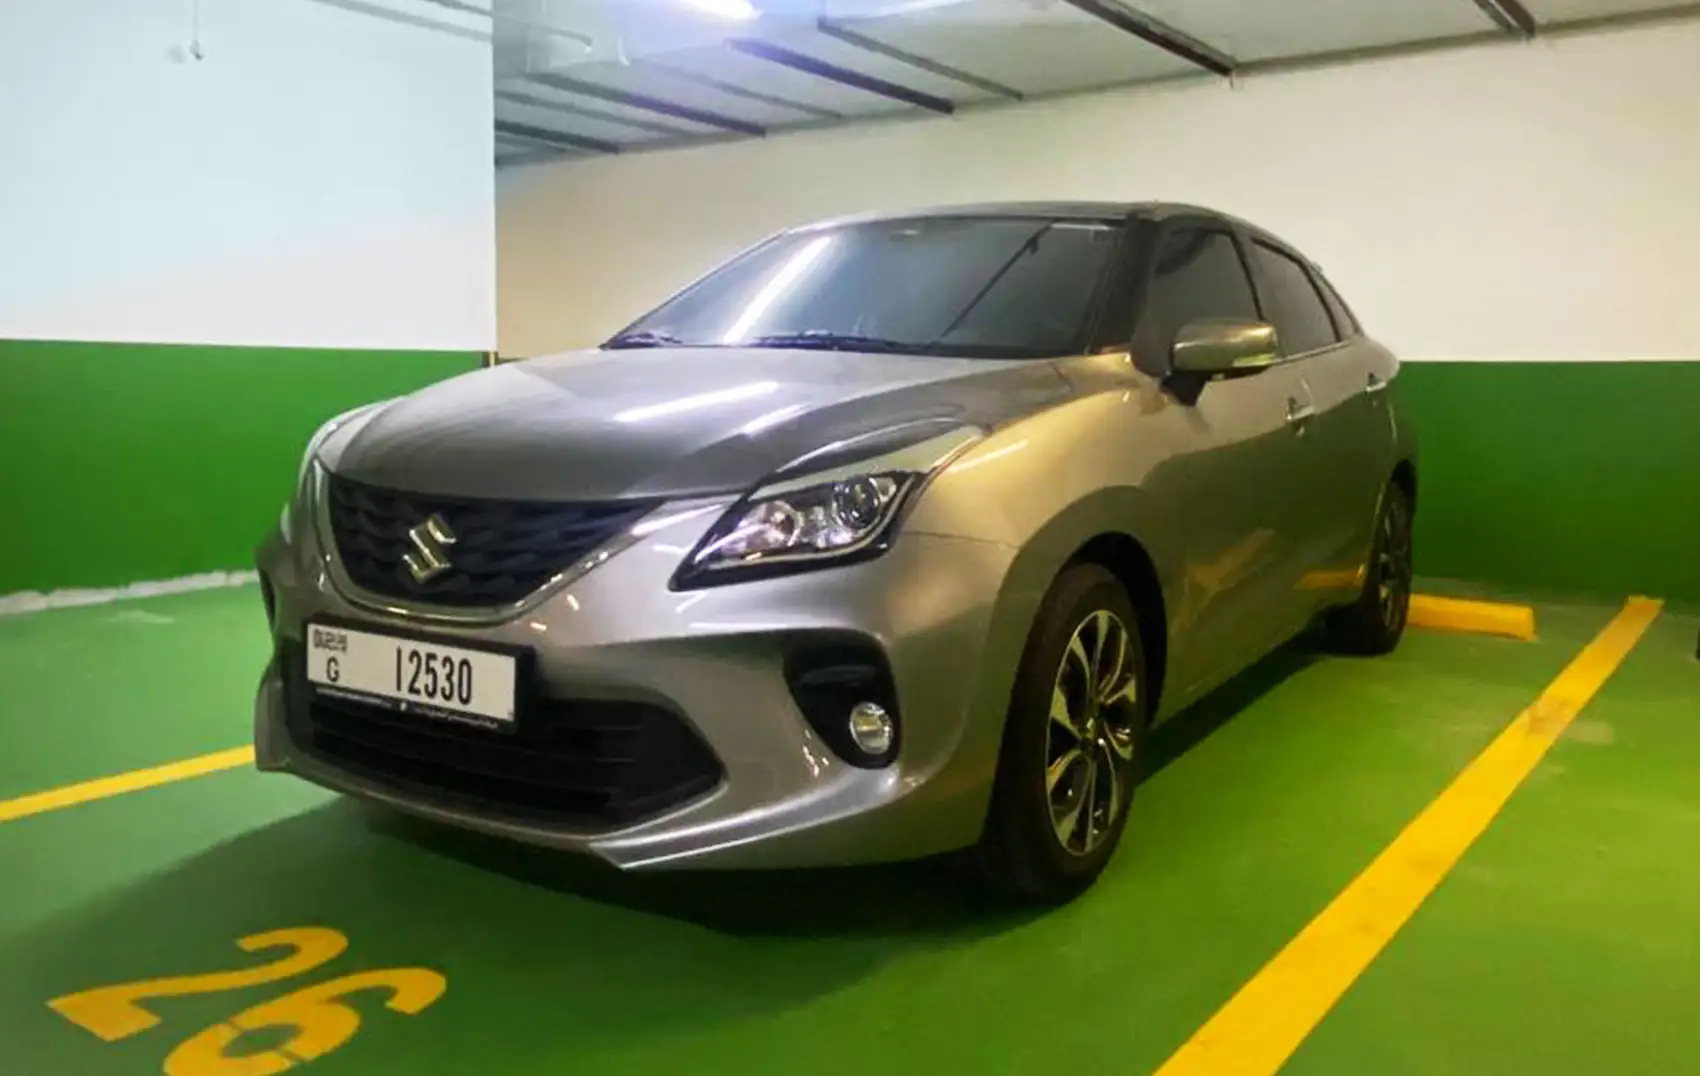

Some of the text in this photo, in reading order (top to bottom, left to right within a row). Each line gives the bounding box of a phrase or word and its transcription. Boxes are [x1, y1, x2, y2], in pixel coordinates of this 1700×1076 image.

[326, 656, 340, 682] G
[396, 646, 472, 705] 12530
[47, 926, 446, 1076] 26
